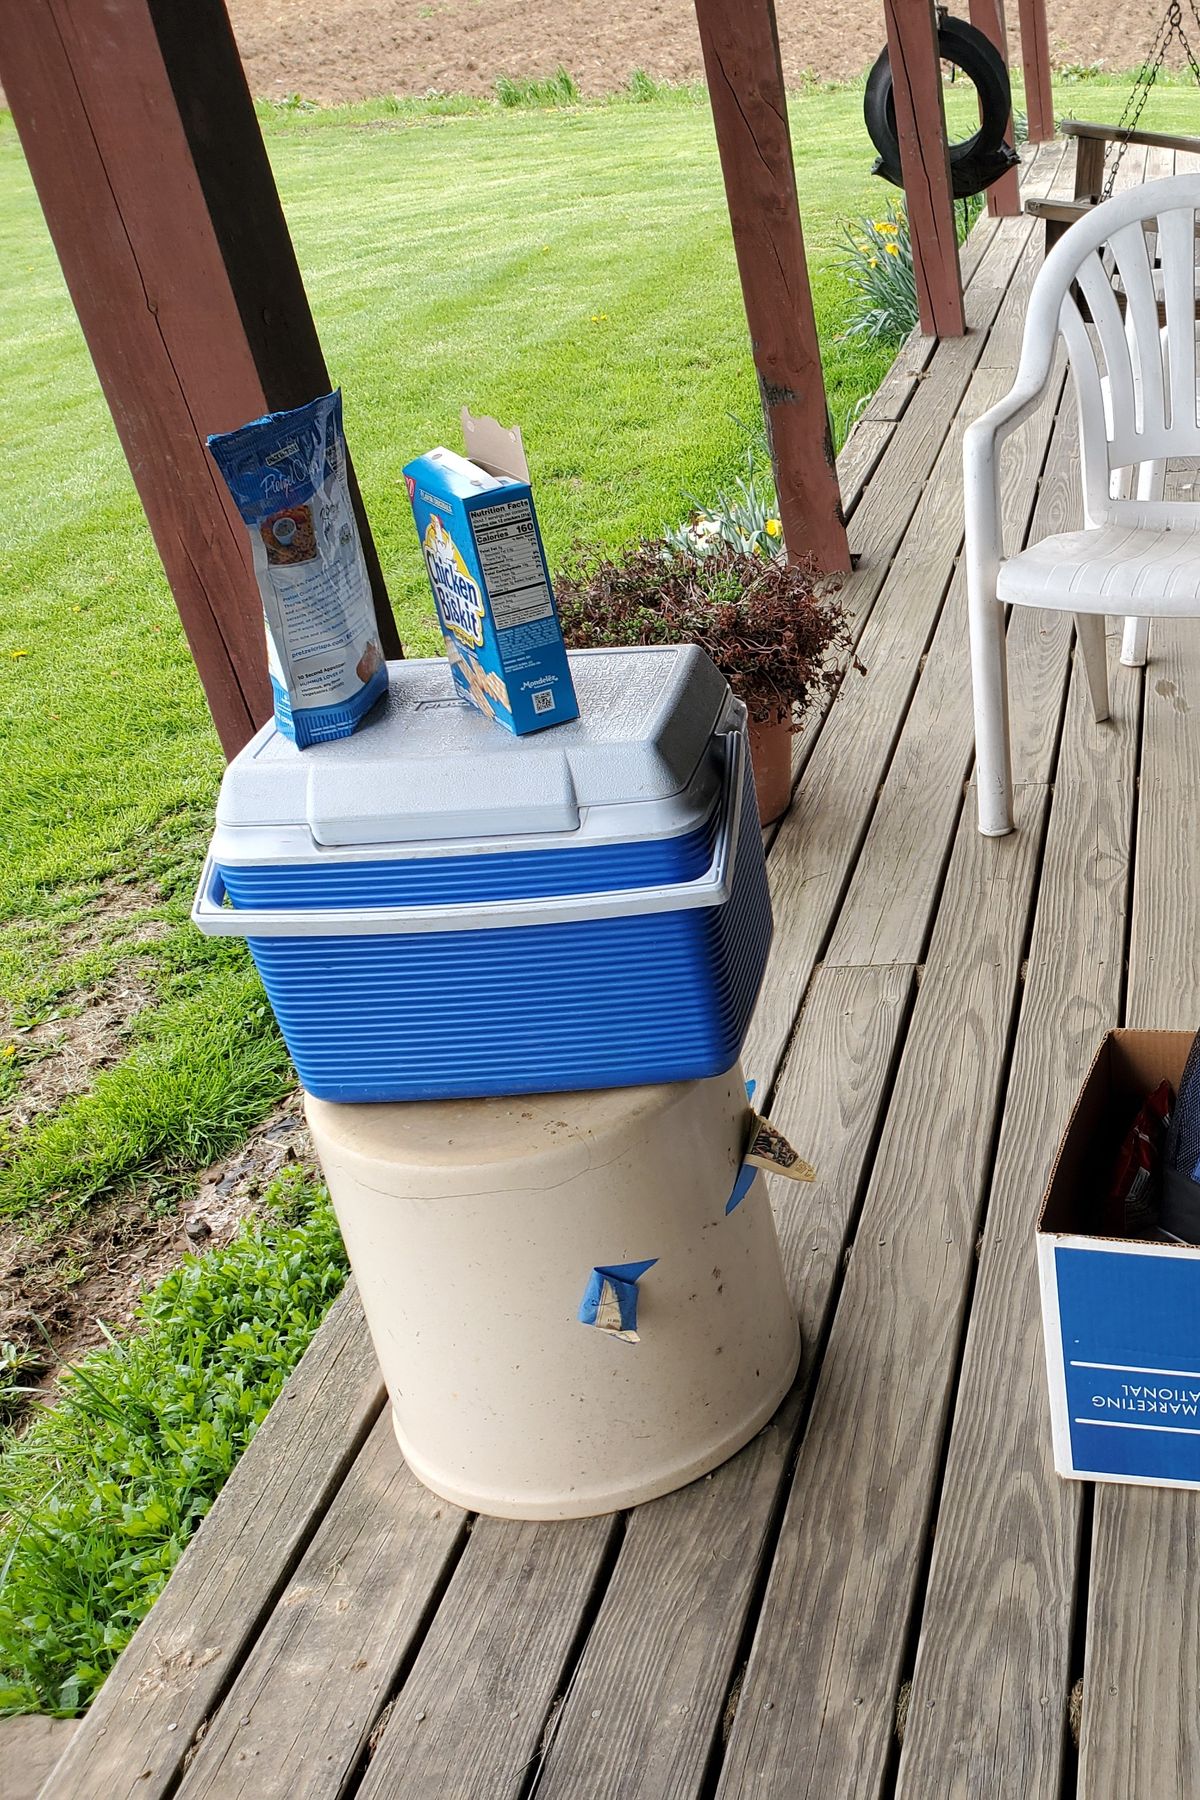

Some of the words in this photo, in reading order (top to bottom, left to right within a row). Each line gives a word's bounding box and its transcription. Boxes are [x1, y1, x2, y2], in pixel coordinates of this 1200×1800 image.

[470, 506, 506, 519] Nutrition
[507, 500, 529, 510] Facts
[476, 531, 509, 543] Calories
[516, 522, 534, 533] 160
[426, 549, 479, 608] Chicken
[436, 586, 479, 638] Biskit
[299, 676, 323, 687] HUMMUS
[305, 669, 323, 679] Second
[1091, 1395, 1198, 1417] MARKETING
